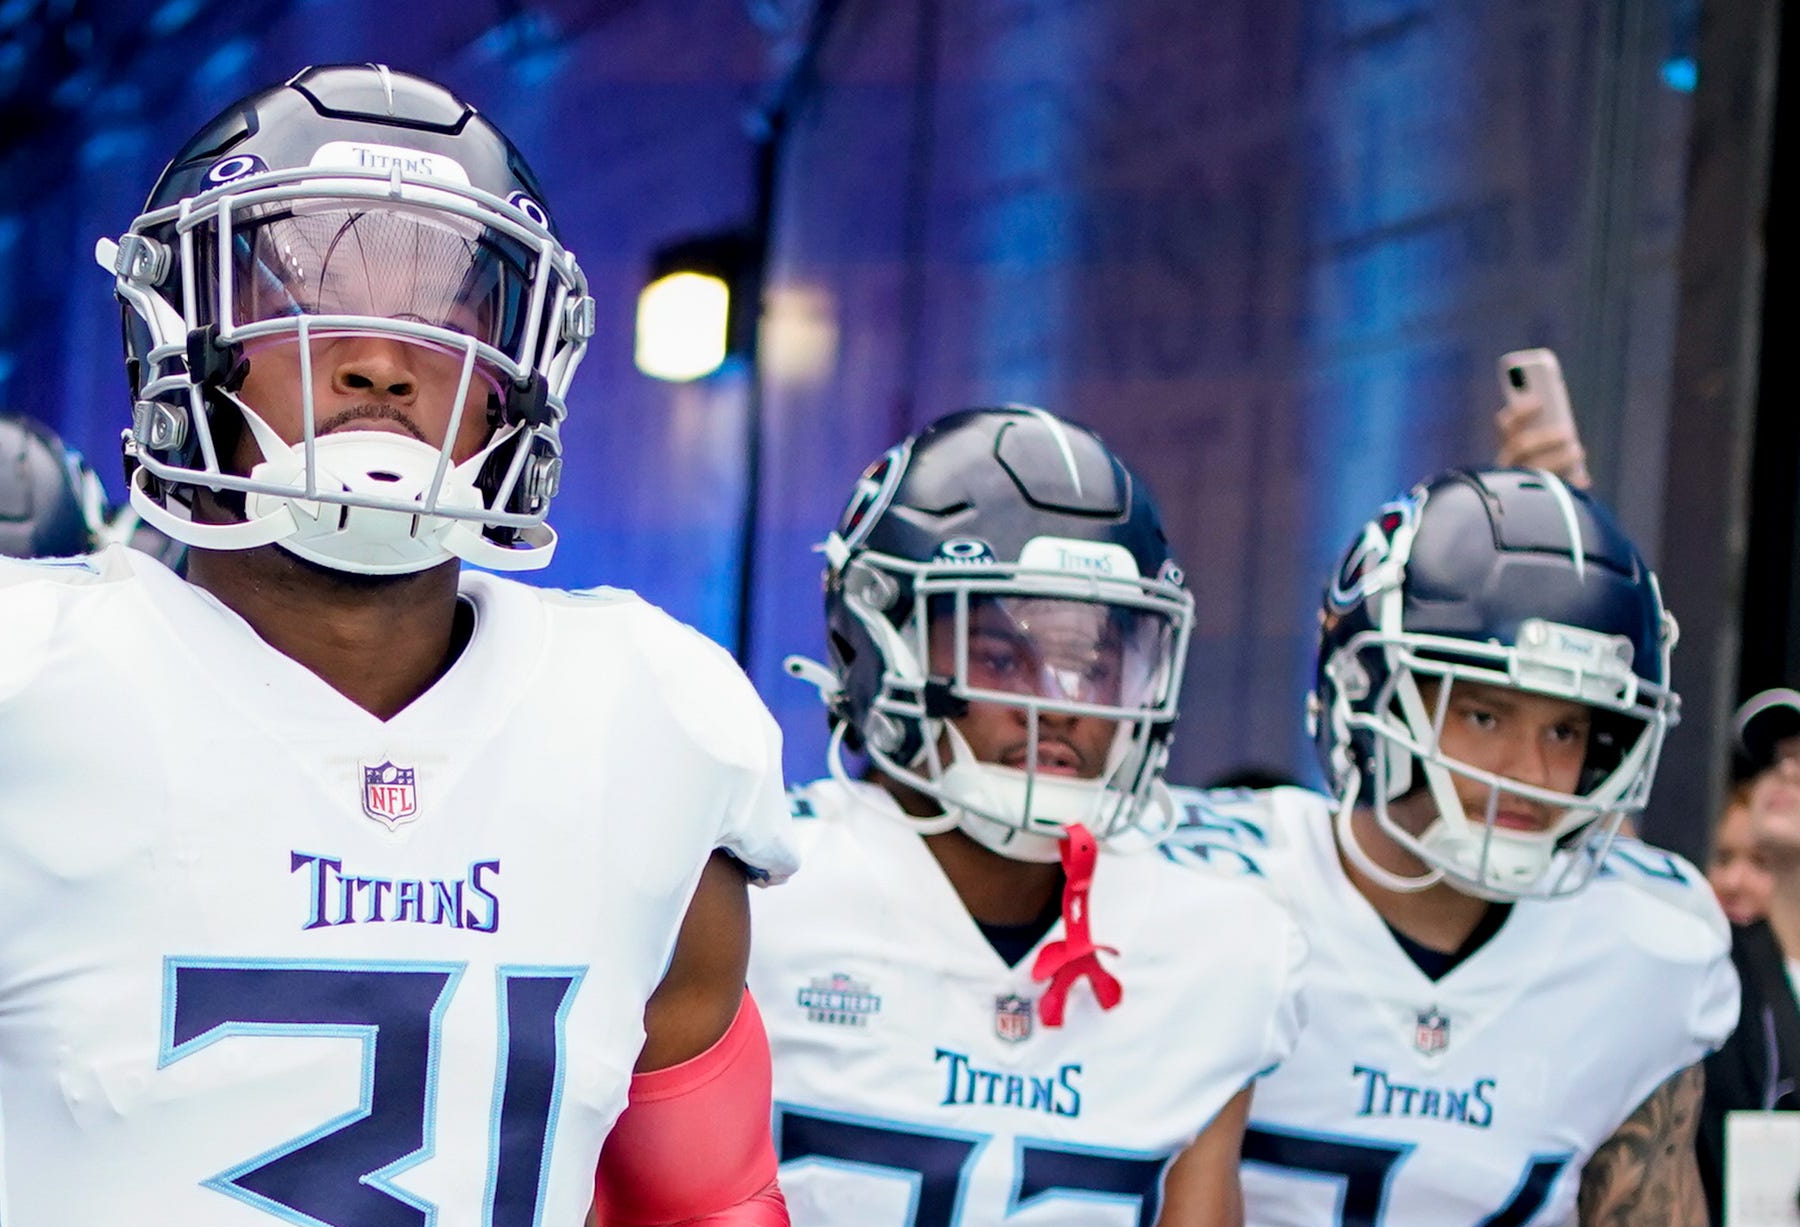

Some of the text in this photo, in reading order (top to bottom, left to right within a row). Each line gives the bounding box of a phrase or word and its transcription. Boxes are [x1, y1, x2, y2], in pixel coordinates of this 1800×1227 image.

[352, 147, 432, 175] TITANS
[371, 786, 413, 815] NFL
[291, 849, 500, 934] TITANS
[935, 1048, 1082, 1119] TITANS
[1352, 1063, 1497, 1129] TITANS
